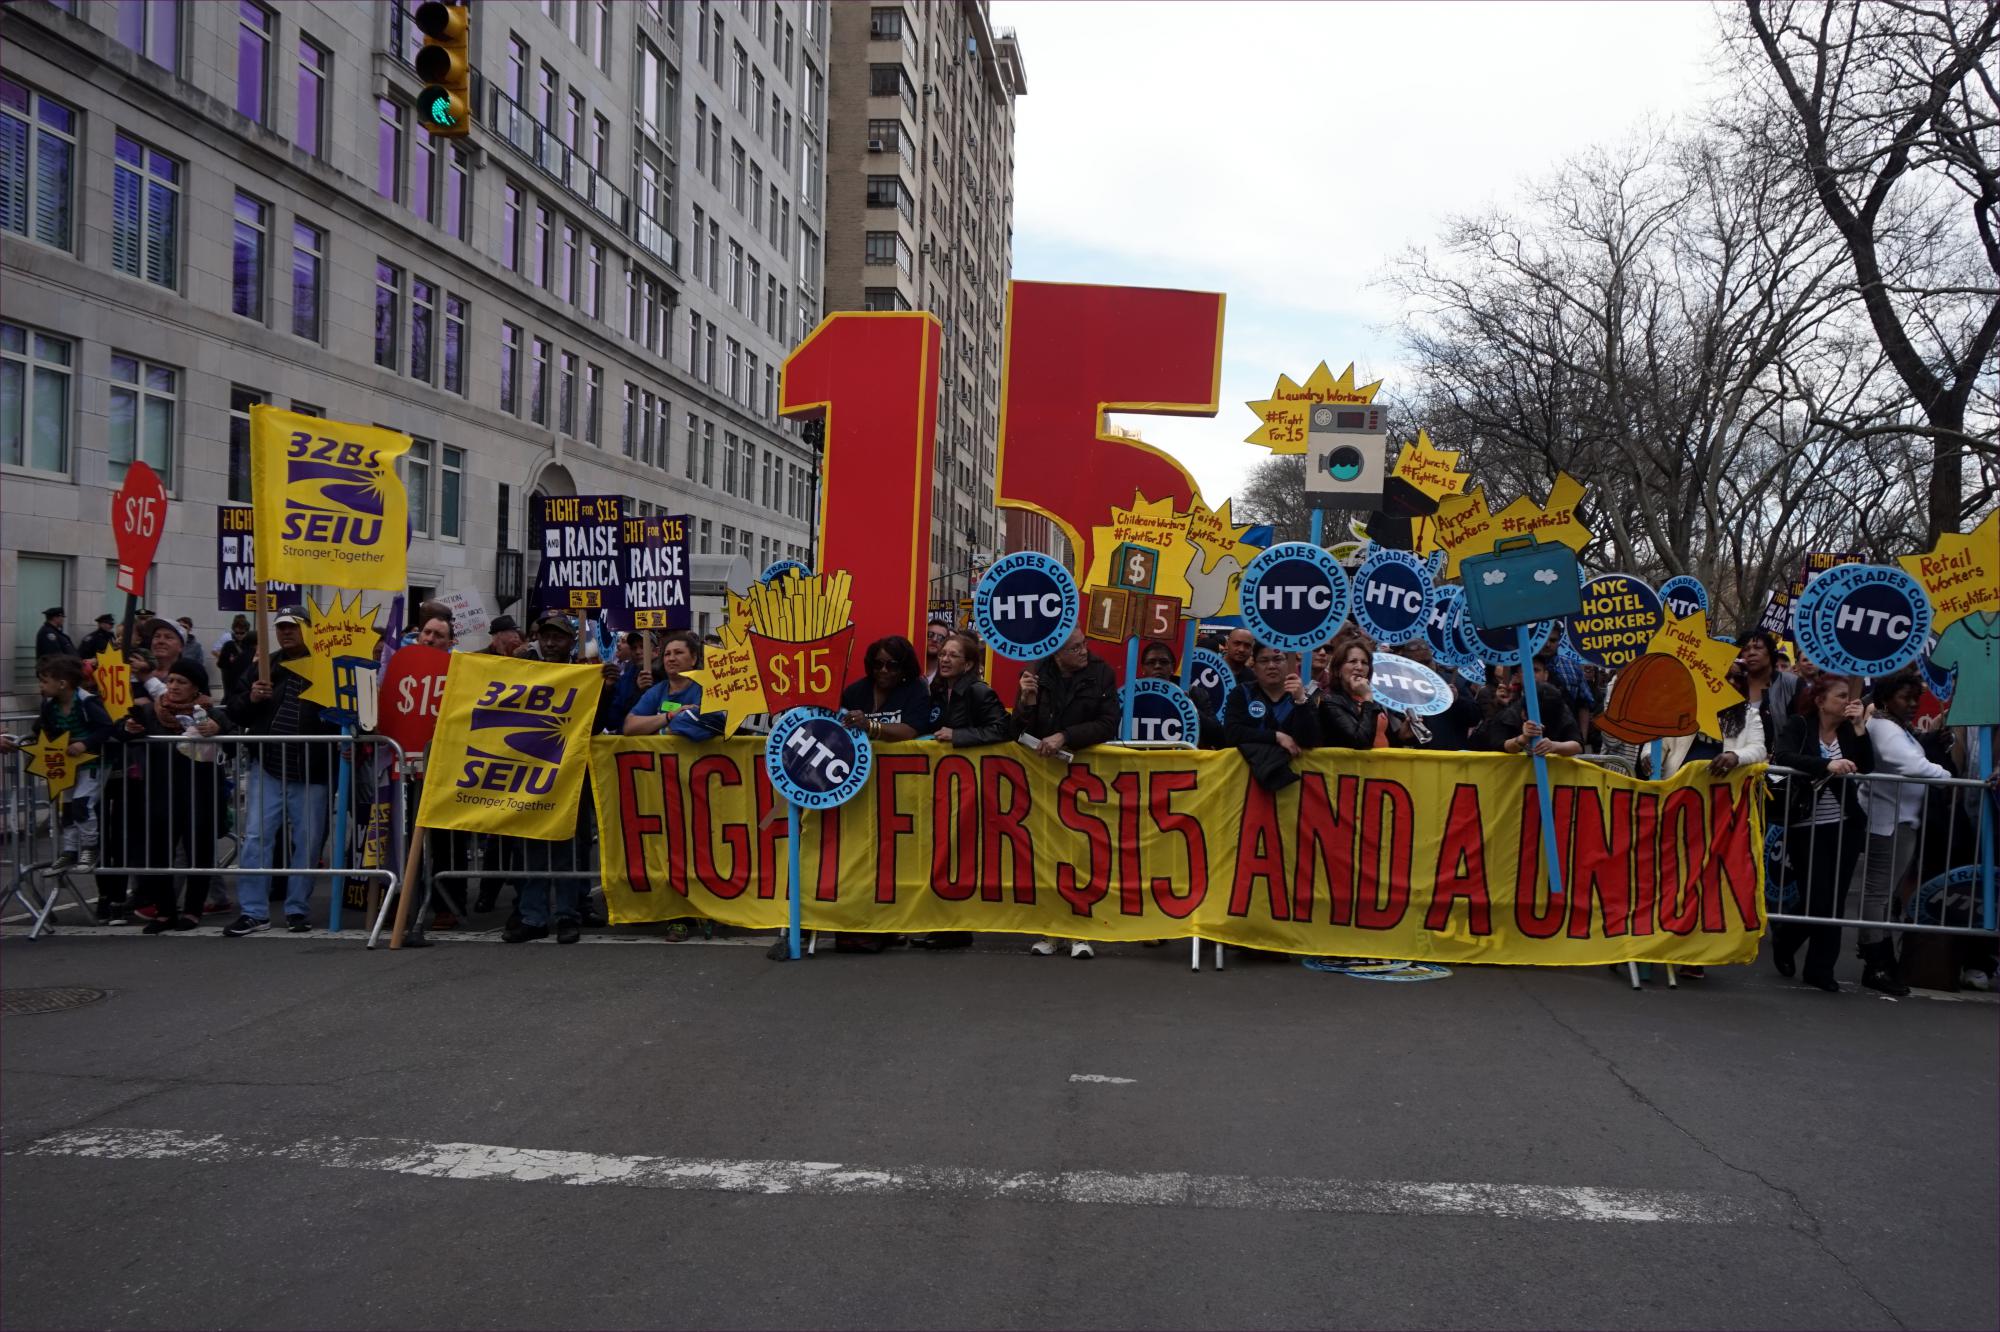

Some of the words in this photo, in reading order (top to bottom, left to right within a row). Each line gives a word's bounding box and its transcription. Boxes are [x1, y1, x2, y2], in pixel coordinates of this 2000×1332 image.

[1277, 388, 1324, 403] Laundry
[1327, 389, 1367, 404] Workers
[1266, 410, 1303, 431] #Fight
[1410, 451, 1451, 471] Adjuncts
[1401, 464, 1457, 490] #FightFor15
[124, 496, 156, 538] $15
[546, 499, 580, 522] FIGHT
[582, 506, 594, 516] FOR
[597, 498, 618, 523] $15
[1117, 513, 1156, 526] Childcare
[1437, 499, 1481, 531] Airport
[1502, 510, 1571, 534] #FightFor15
[281, 512, 383, 546] SEIU
[548, 541, 559, 549] AND
[565, 526, 619, 558] RAISE
[624, 520, 645, 543] GHT
[648, 526, 659, 537] FOR
[662, 519, 683, 543] $15
[1114, 528, 1173, 547] #FightFor15
[1188, 527, 1236, 550] ightFor15
[1441, 520, 1490, 549] Workers
[225, 546, 236, 554] AND
[283, 545, 331, 560] Stronger
[333, 549, 384, 563] Together
[631, 546, 683, 578] RAISE
[1920, 548, 1972, 577] Retail
[549, 560, 619, 587] AMERICA
[986, 556, 1045, 586] TRADES
[1129, 554, 1145, 584] $
[1925, 566, 1985, 593] Workers
[625, 579, 685, 609] MERICA
[1049, 563, 1076, 631] COUNCIL
[1243, 576, 1261, 628] HOTEL
[1253, 546, 1317, 573] TRADES
[1320, 557, 1346, 623] COUNCIL
[1259, 585, 1331, 609] HTC
[1354, 571, 1370, 616] HOTEL
[1368, 552, 1417, 568] TRADES
[1415, 568, 1433, 628] COUNCIL
[1366, 580, 1422, 614] HTC
[1436, 588, 1457, 598] TRA
[1592, 579, 1627, 596] NYC
[1668, 578, 1698, 589] TRADES
[977, 588, 996, 640] HOTEL
[992, 593, 1062, 620] HTC
[1583, 594, 1644, 616] HOTEL
[1821, 593, 1842, 648] HOTEL
[1842, 571, 1908, 591] TRADES
[1901, 588, 1928, 656] COUNCIL
[1939, 588, 1999, 613] #FightFor1
[1102, 598, 1111, 629] 1
[1154, 605, 1169, 634] 5
[1463, 607, 1479, 647] HOTE
[1574, 611, 1656, 635] WORKERS
[1799, 601, 1818, 653] HOTEL
[1836, 604, 1912, 640] HTC
[997, 636, 1059, 657] AFL-CIO
[1261, 629, 1326, 648] AFL-CIO
[1363, 622, 1412, 643] AFL-CIO
[1582, 629, 1655, 651] SUPPORT
[1665, 620, 1701, 649] Trades
[707, 654, 728, 668] Fast
[728, 650, 750, 663] Food
[1479, 651, 1520, 663] AFL-C
[1601, 649, 1636, 667] YOU
[1676, 644, 1723, 694] #FightFor15
[1832, 651, 1895, 673] AFL-CIO
[97, 665, 127, 705] $15
[712, 665, 749, 681] Workers
[769, 648, 832, 695] $15
[1371, 672, 1435, 694] HTC
[397, 674, 447, 717] $15
[477, 681, 578, 714] 32BJ
[706, 675, 759, 701] #FightFor15
[807, 707, 862, 739] TRAS
[1172, 692, 1196, 743] COUNC
[769, 712, 803, 755] HOTEL
[786, 726, 850, 784] HTC
[456, 760, 559, 795] SEIU
[770, 766, 821, 806] AFL-CIO
[829, 743, 868, 802] COUNCIL
[456, 792, 505, 809] Stronger
[506, 797, 556, 812] Together
[876, 754, 1037, 904] FOR
[1056, 763, 1208, 920] $15
[1227, 771, 1414, 931] AND
[1424, 783, 1491, 937] A
[1513, 774, 1761, 940] UNION
